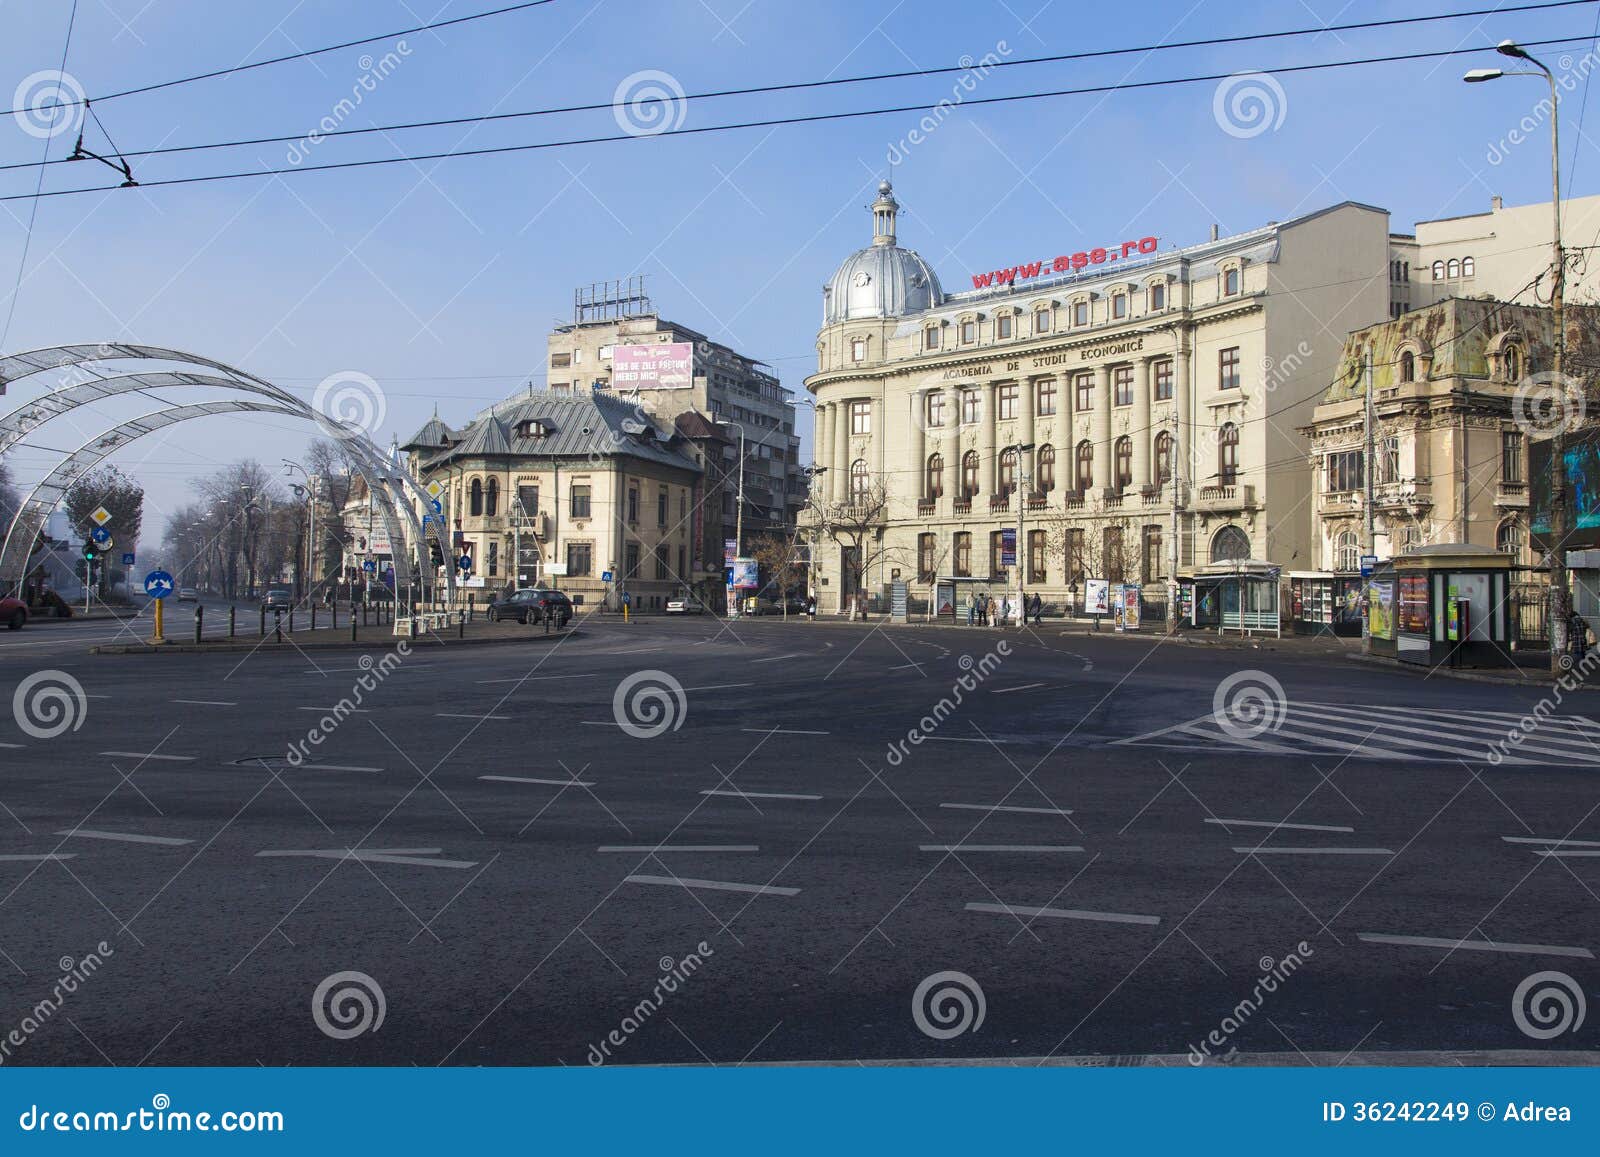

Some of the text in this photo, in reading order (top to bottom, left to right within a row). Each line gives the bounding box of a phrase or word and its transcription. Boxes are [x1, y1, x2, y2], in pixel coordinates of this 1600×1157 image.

[971, 235, 1158, 289] www.ase.ro
[943, 338, 1144, 380] ACADEMIA DE STUDII ECONOMICE
